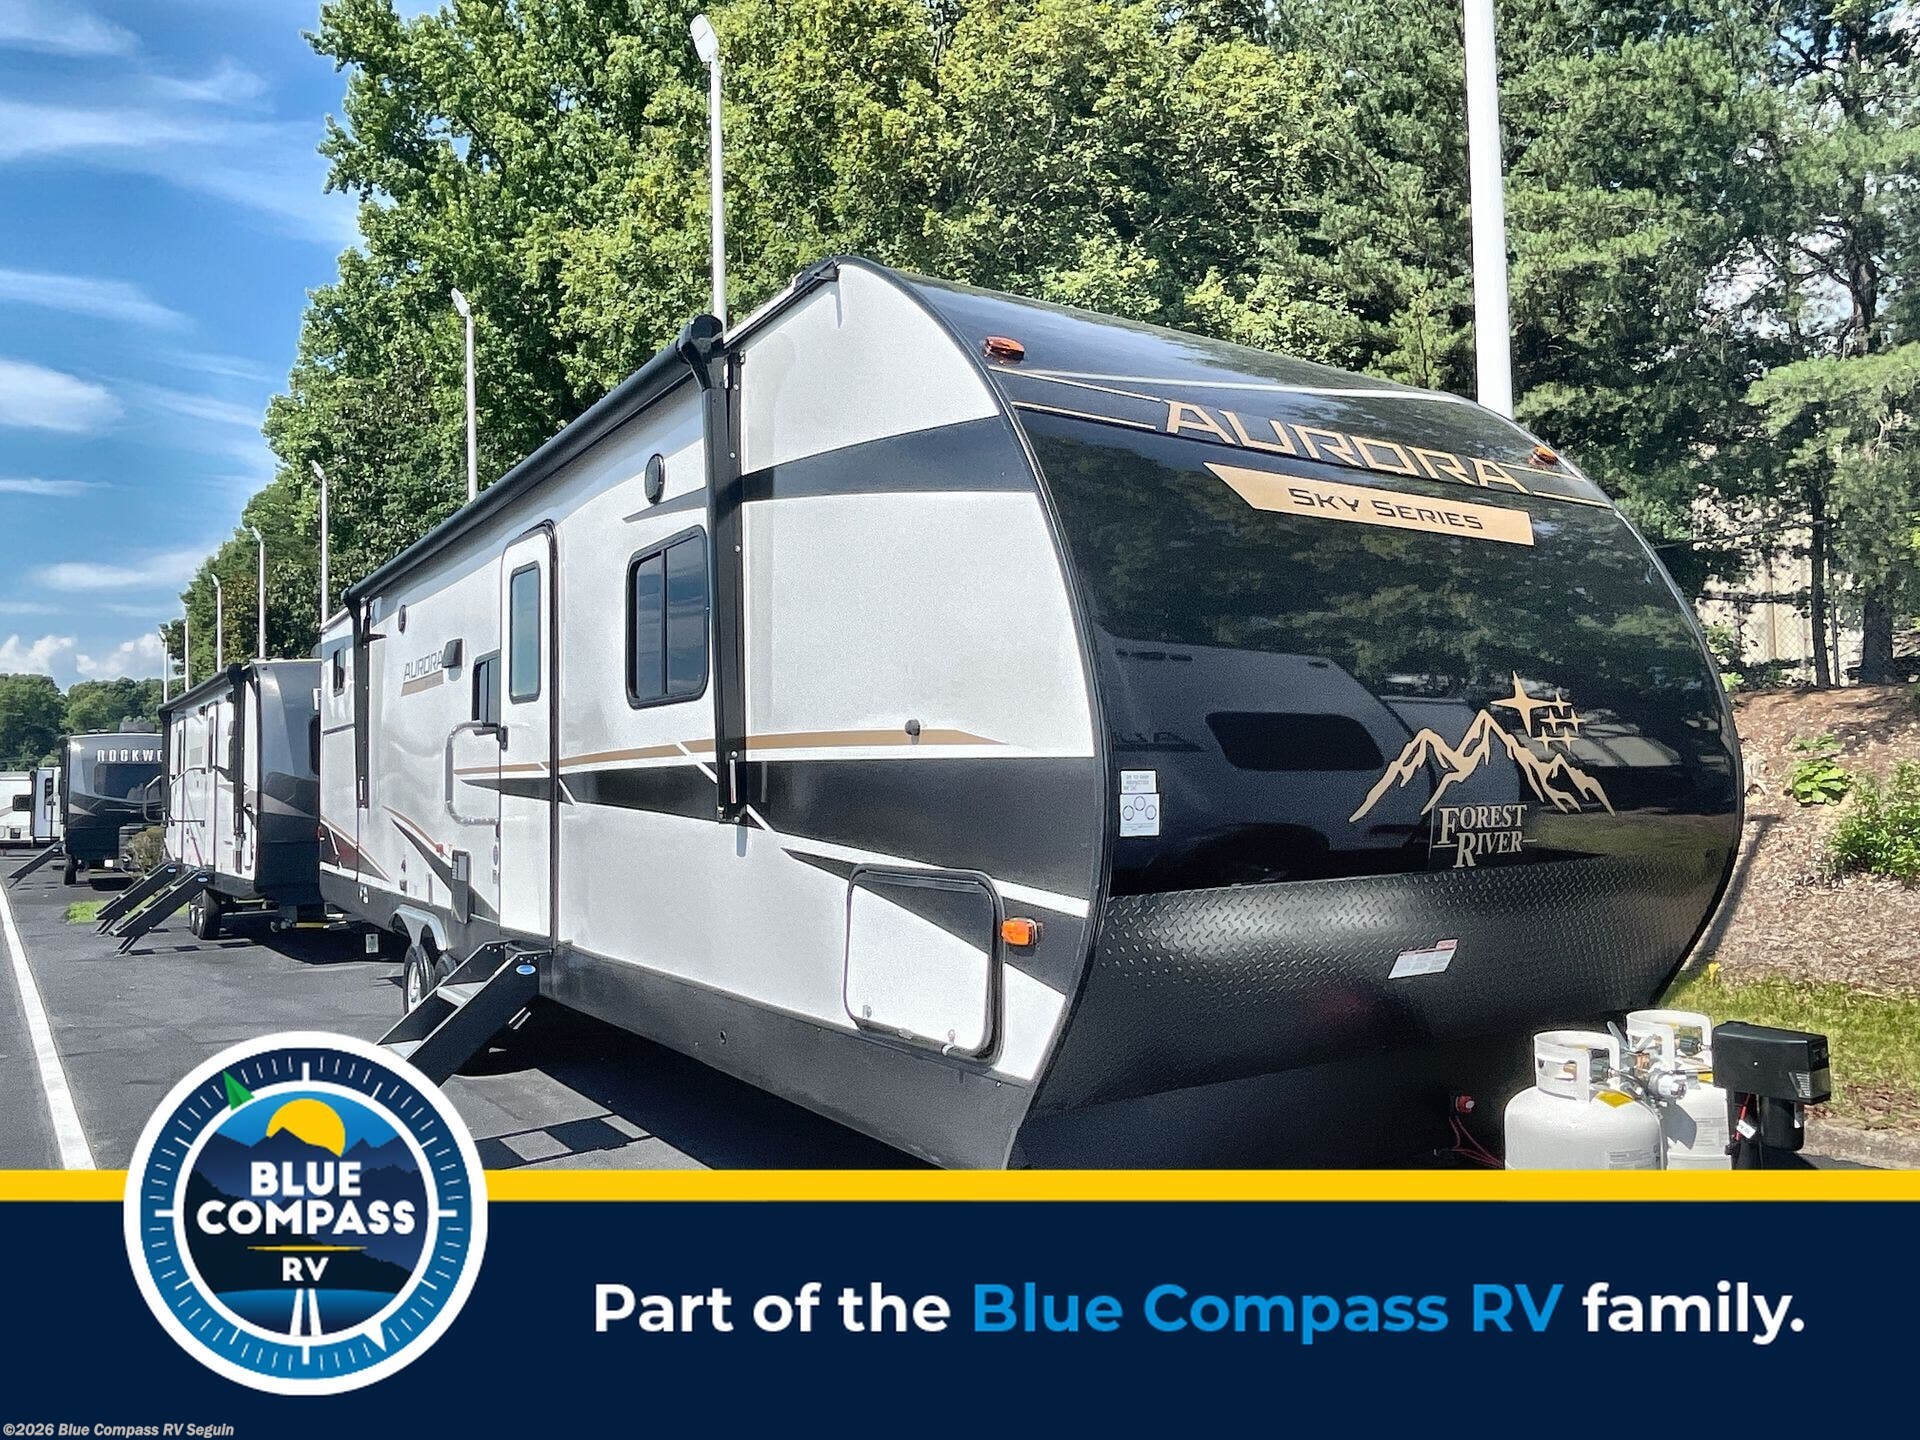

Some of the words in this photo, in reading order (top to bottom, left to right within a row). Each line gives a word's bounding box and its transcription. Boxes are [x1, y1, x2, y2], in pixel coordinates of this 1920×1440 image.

[1166, 399, 1531, 496] AURORA
[1287, 487, 1360, 513] SKY
[1366, 500, 1484, 531] SERIES
[1437, 804, 1528, 845] FOREST
[1453, 831, 1523, 868] RIVER
